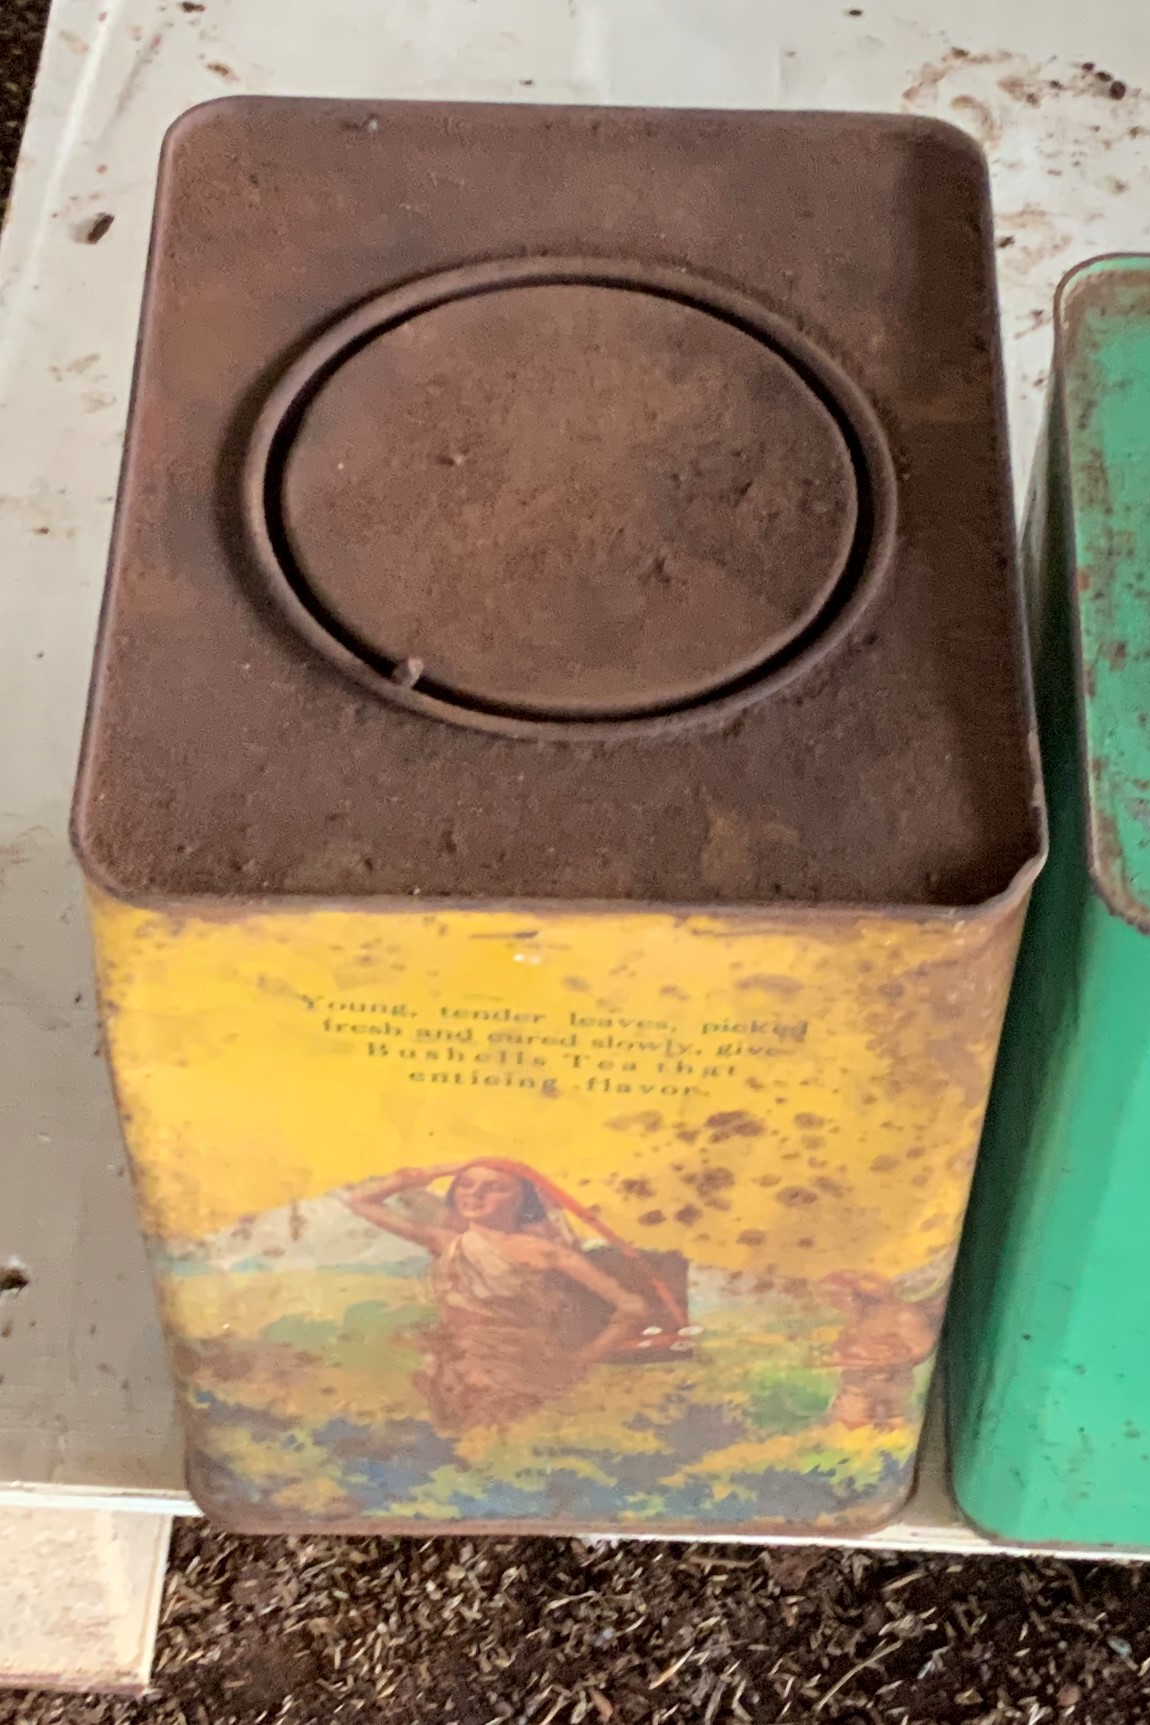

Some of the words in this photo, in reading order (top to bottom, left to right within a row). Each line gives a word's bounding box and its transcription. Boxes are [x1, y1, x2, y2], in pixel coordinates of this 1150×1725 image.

[440, 1006, 546, 1025] tender
[569, 1011, 677, 1034] leaves,
[323, 1017, 402, 1036] fresh
[415, 1026, 474, 1044] and
[486, 1033, 577, 1049] cured
[716, 1041, 792, 1058] give
[366, 1042, 547, 1067] Bushells
[563, 1052, 638, 1073] Tea
[656, 1059, 738, 1079] that
[408, 1071, 560, 1098] enticing
